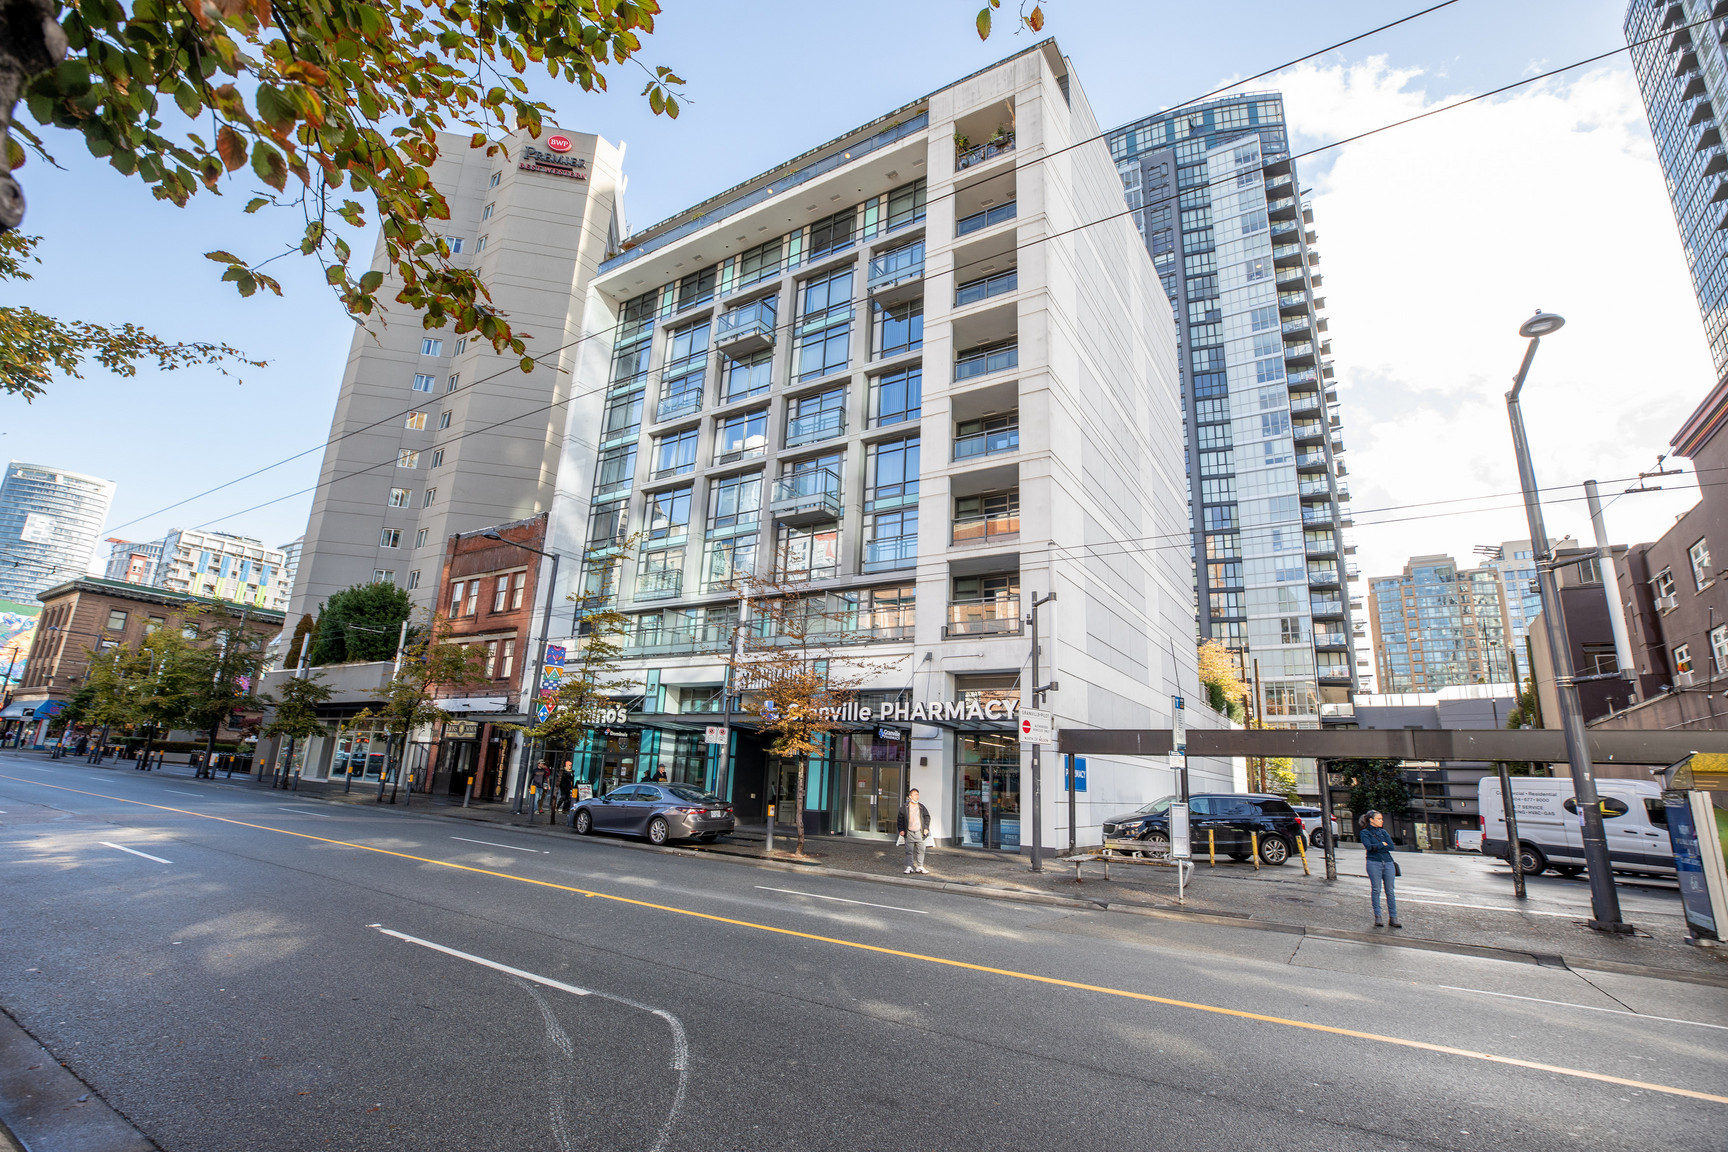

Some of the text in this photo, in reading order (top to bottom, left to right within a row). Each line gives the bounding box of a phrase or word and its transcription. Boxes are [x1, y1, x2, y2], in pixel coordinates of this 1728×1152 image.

[551, 138, 568, 146] BWP
[523, 146, 586, 169] PREMIER
[519, 162, 586, 180] BEST WESTERN
[786, 700, 1018, 721] nville PHARMACY
[1066, 768, 1086, 778] PMACY
